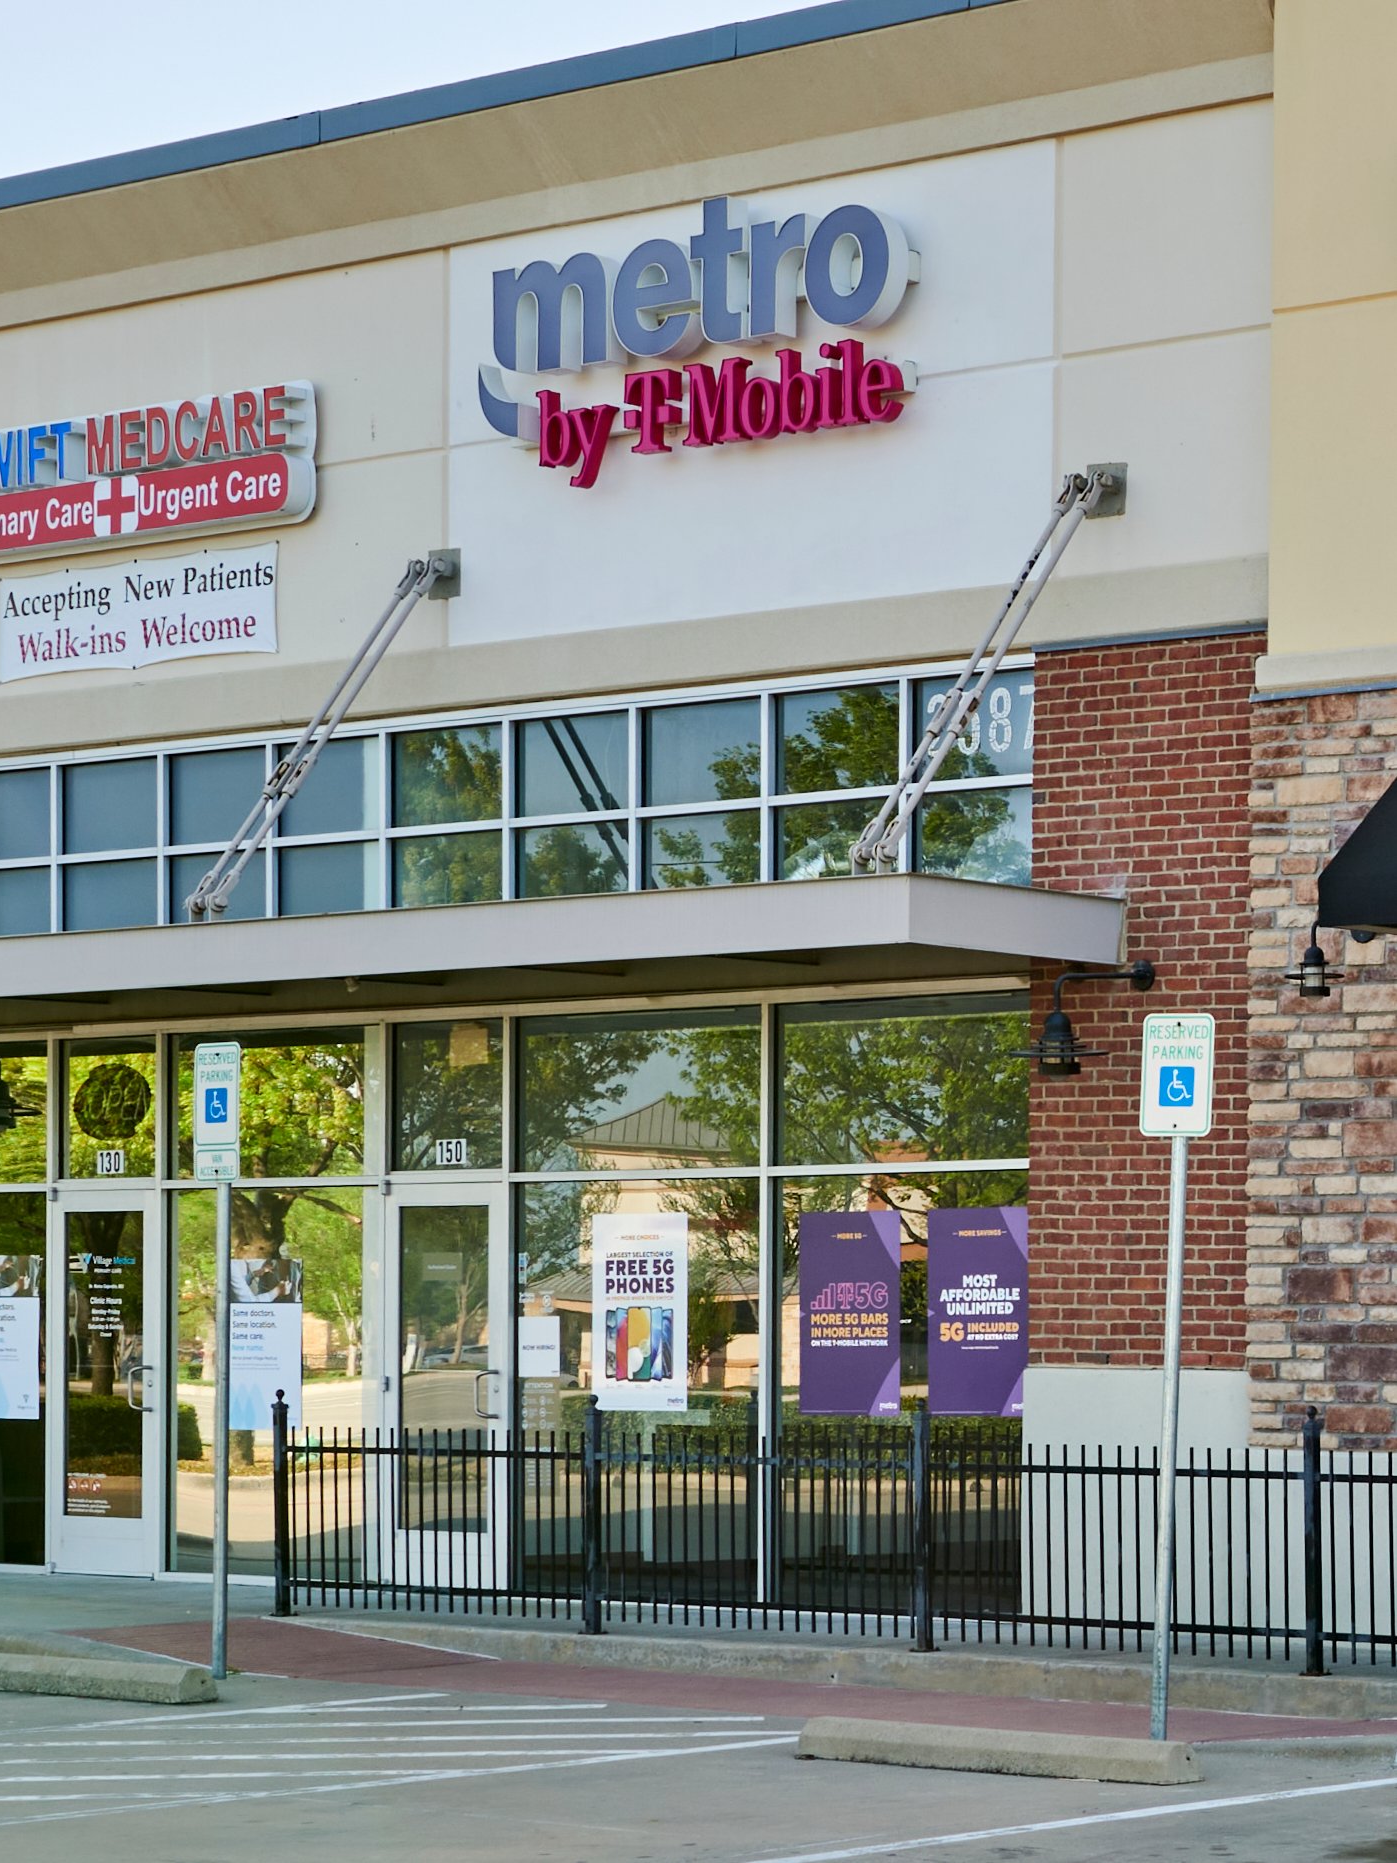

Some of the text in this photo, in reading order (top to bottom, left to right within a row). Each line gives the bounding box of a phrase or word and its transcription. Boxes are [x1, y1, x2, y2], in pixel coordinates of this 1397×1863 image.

[491, 194, 894, 376] metro
[85, 384, 288, 477] MEDCARE
[535, 389, 620, 490] by
[45, 497, 93, 530] Care
[139, 475, 219, 520] Urgent
[225, 470, 282, 503] Care
[3, 561, 274, 621] Accepting New Patients
[17, 613, 257, 664] Walk-ins Welcome
[1149, 1025, 1210, 1040] RESERVED
[198, 1052, 236, 1065] RESERVED
[1151, 1045, 1204, 1060] PARKING
[200, 1069, 234, 1083] PARKING
[438, 1140, 463, 1164] 150
[99, 1151, 121, 1174] 130
[606, 1251, 632, 1259] LARGEST
[632, 1250, 664, 1258] SELECTION
[605, 1258, 675, 1276] FREE 5G
[605, 1277, 675, 1294] PHONES
[962, 1274, 998, 1288] MOST
[939, 1287, 1021, 1303] AFFORDABLE
[946, 1301, 1014, 1316] UNLIMITED
[810, 1313, 843, 1326] MORE
[844, 1313, 860, 1326] 5G
[860, 1312, 890, 1326] BARS
[810, 1326, 890, 1338] IN MORE PLACES
[939, 1321, 1020, 1342] 5G INCLUDED
